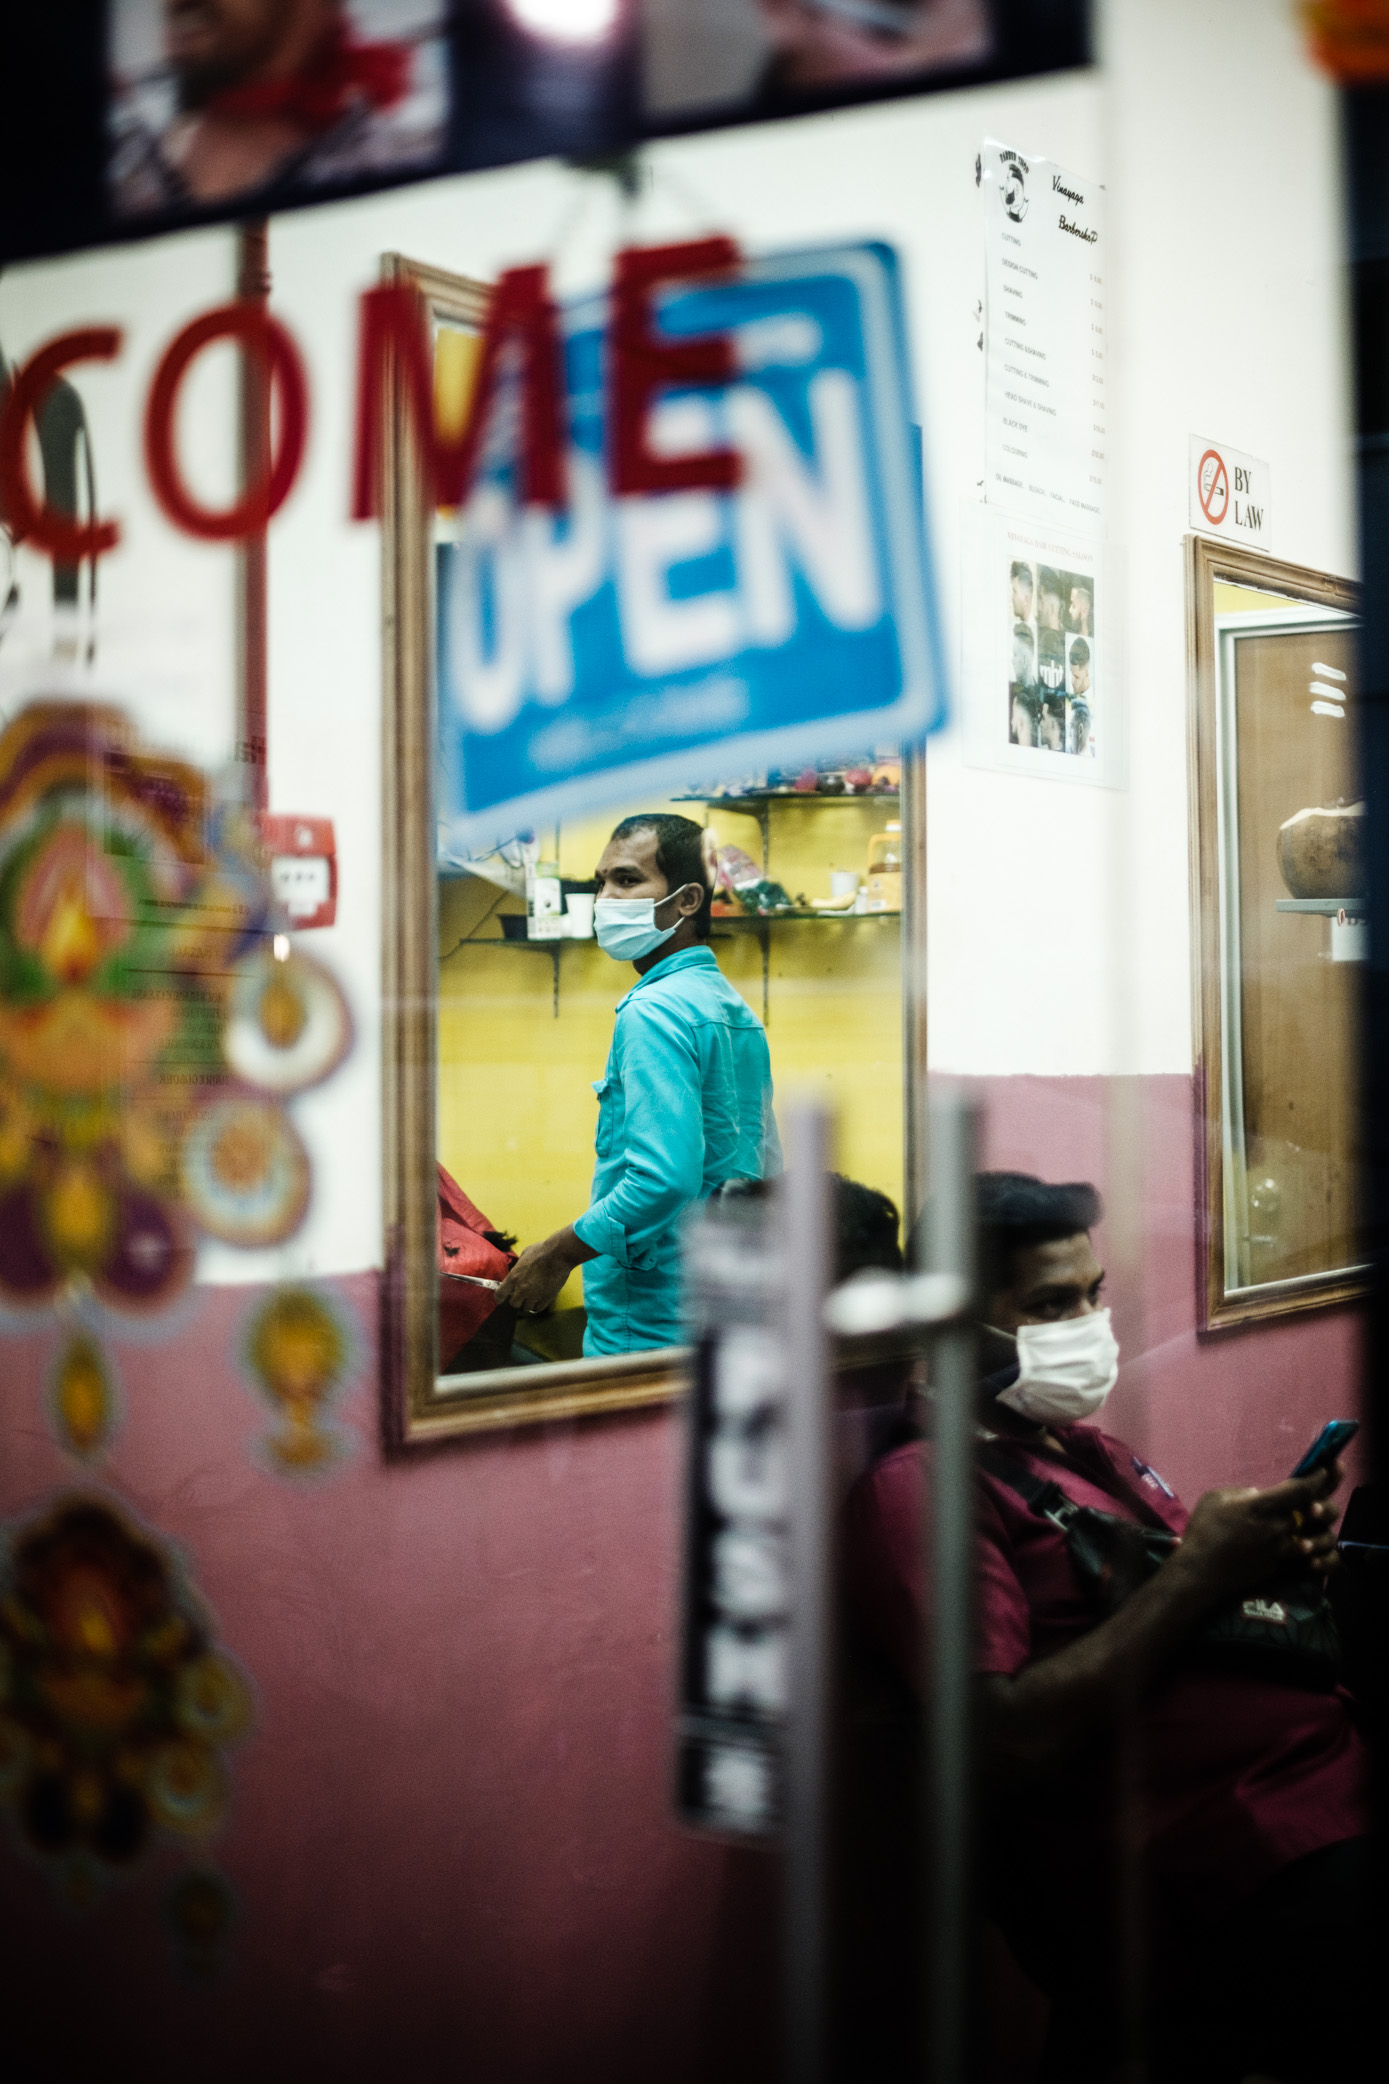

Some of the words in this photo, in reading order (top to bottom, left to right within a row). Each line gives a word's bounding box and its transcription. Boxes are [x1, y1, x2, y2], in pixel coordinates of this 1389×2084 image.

[1052, 175, 1084, 206] Vinayaga
[1001, 232, 1021, 247] CUTTING
[1018, 265, 1038, 280] CUTTING
[0, 233, 745, 560] COME
[1234, 466, 1252, 495] BY
[1234, 500, 1264, 531] LAW
[450, 370, 882, 735] OPEN
